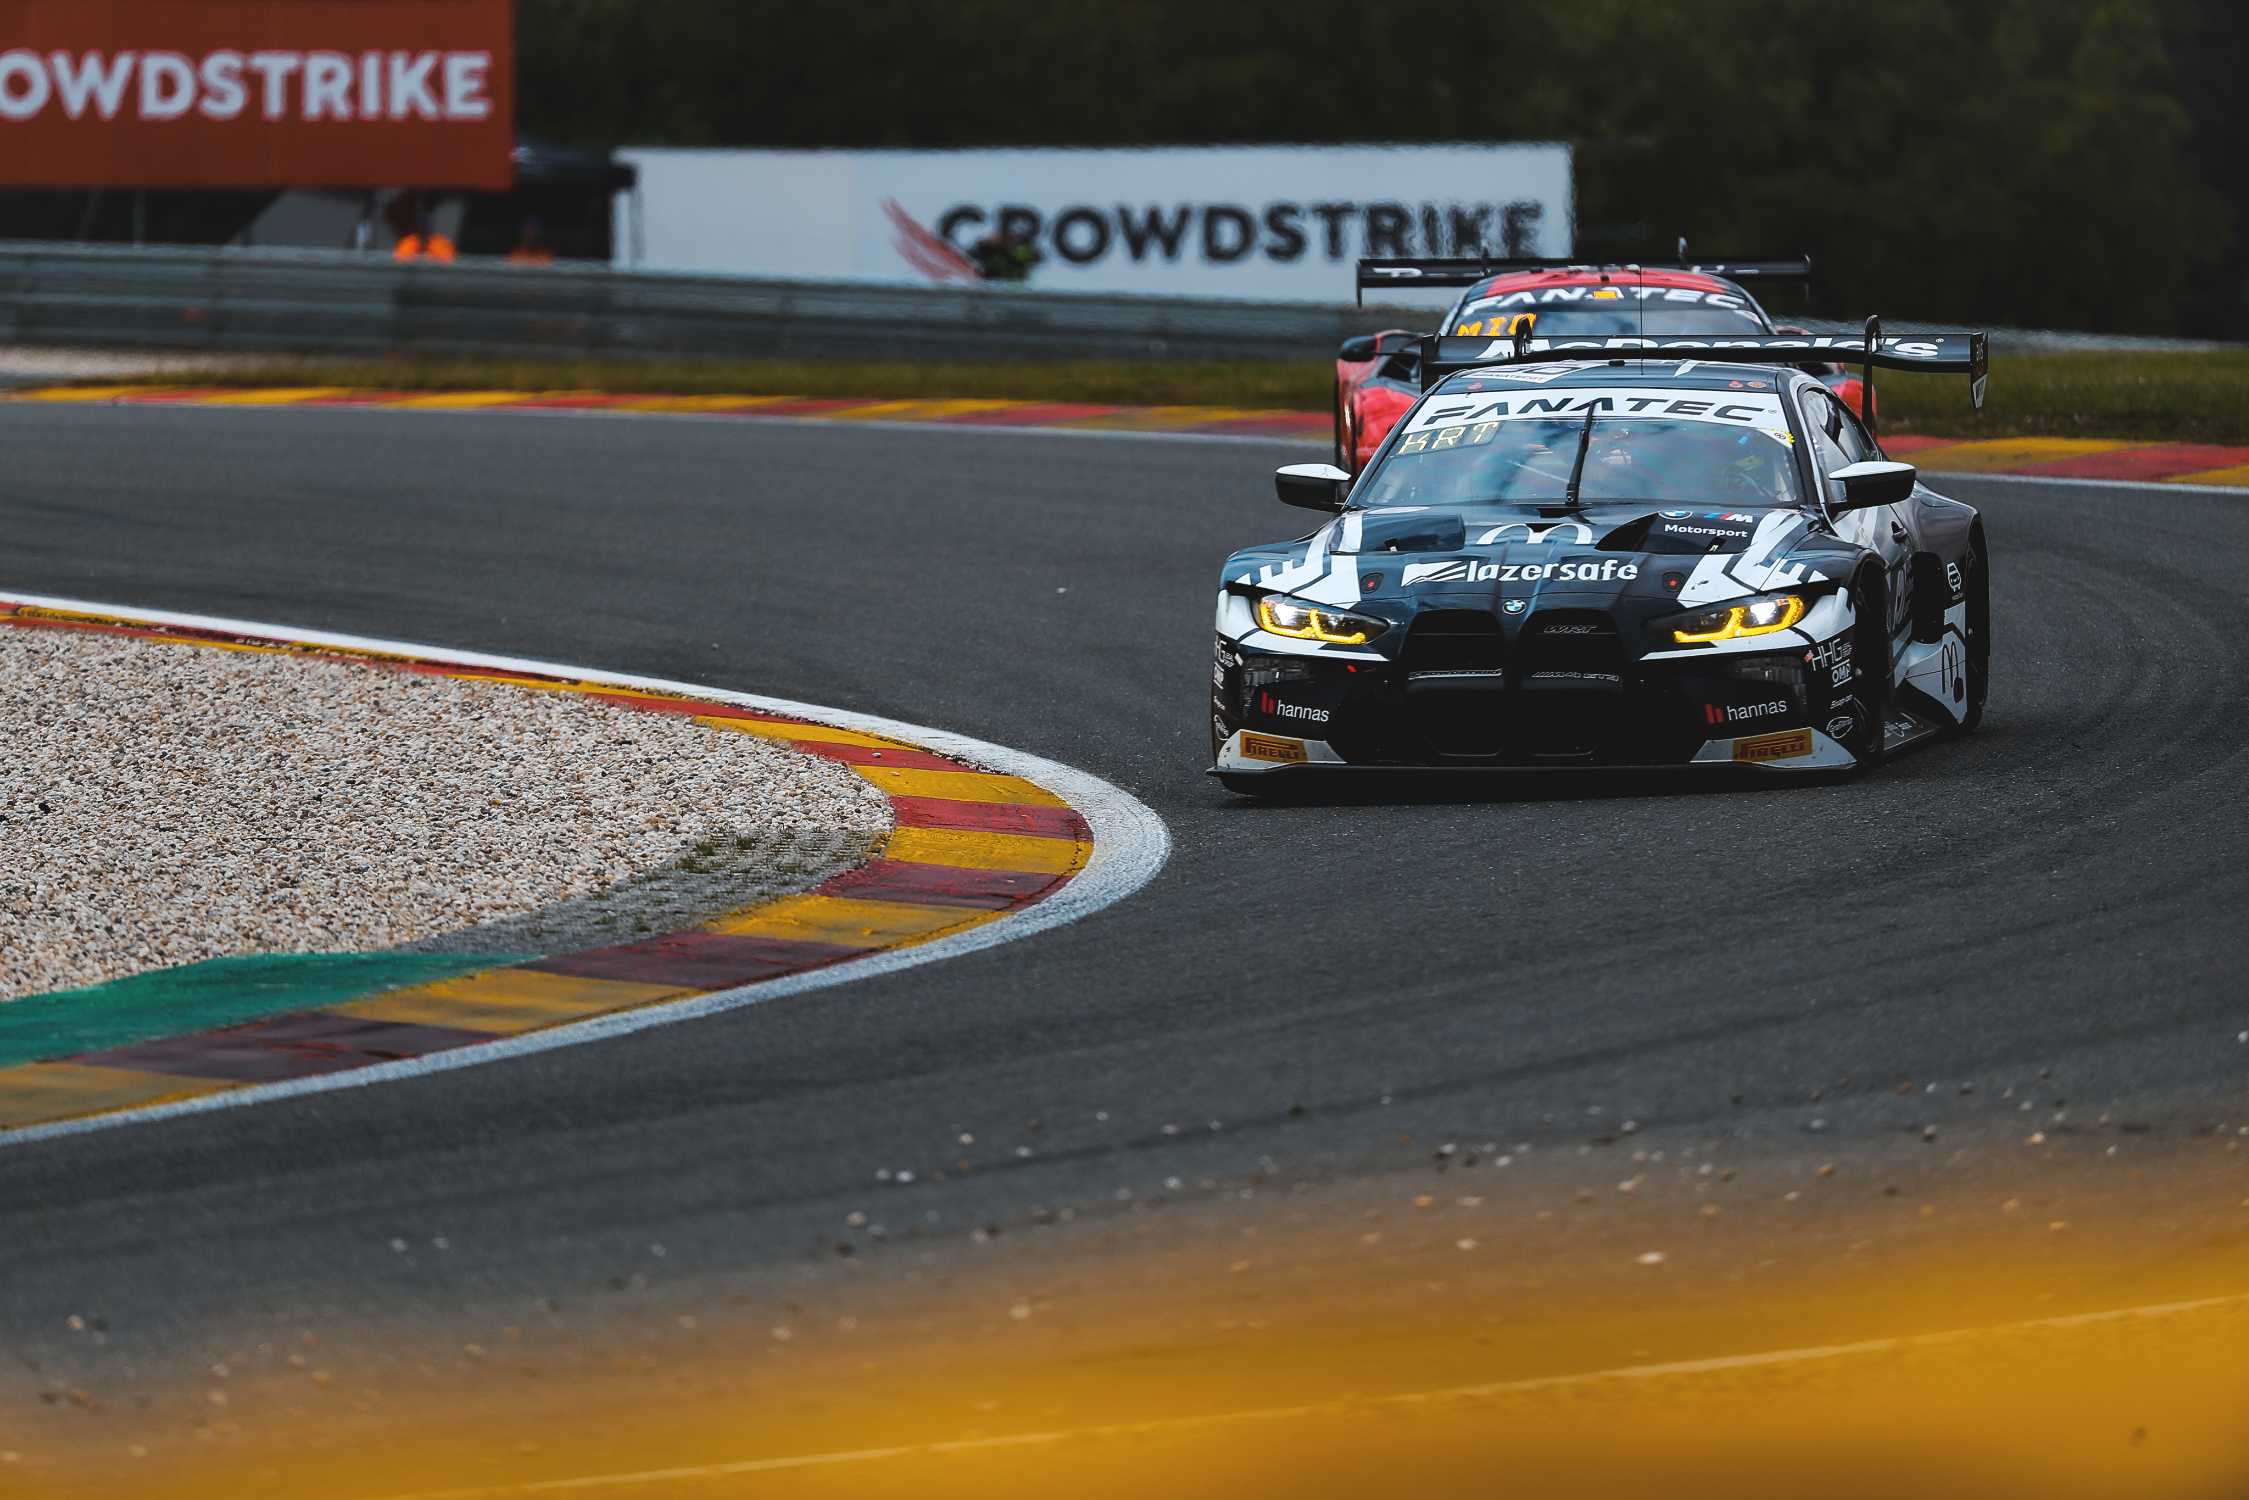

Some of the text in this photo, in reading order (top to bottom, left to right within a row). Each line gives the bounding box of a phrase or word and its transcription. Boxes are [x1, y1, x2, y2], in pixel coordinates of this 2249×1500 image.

[937, 201, 1544, 265] CROWDSTRIKE
[1423, 397, 1765, 426] FANATEC
[1398, 421, 1499, 455] KRT
[1664, 524, 1748, 538] Motorsport
[1467, 559, 1638, 583] lazersafe
[1277, 700, 1330, 722] hannas
[1727, 700, 1788, 721] hannas
